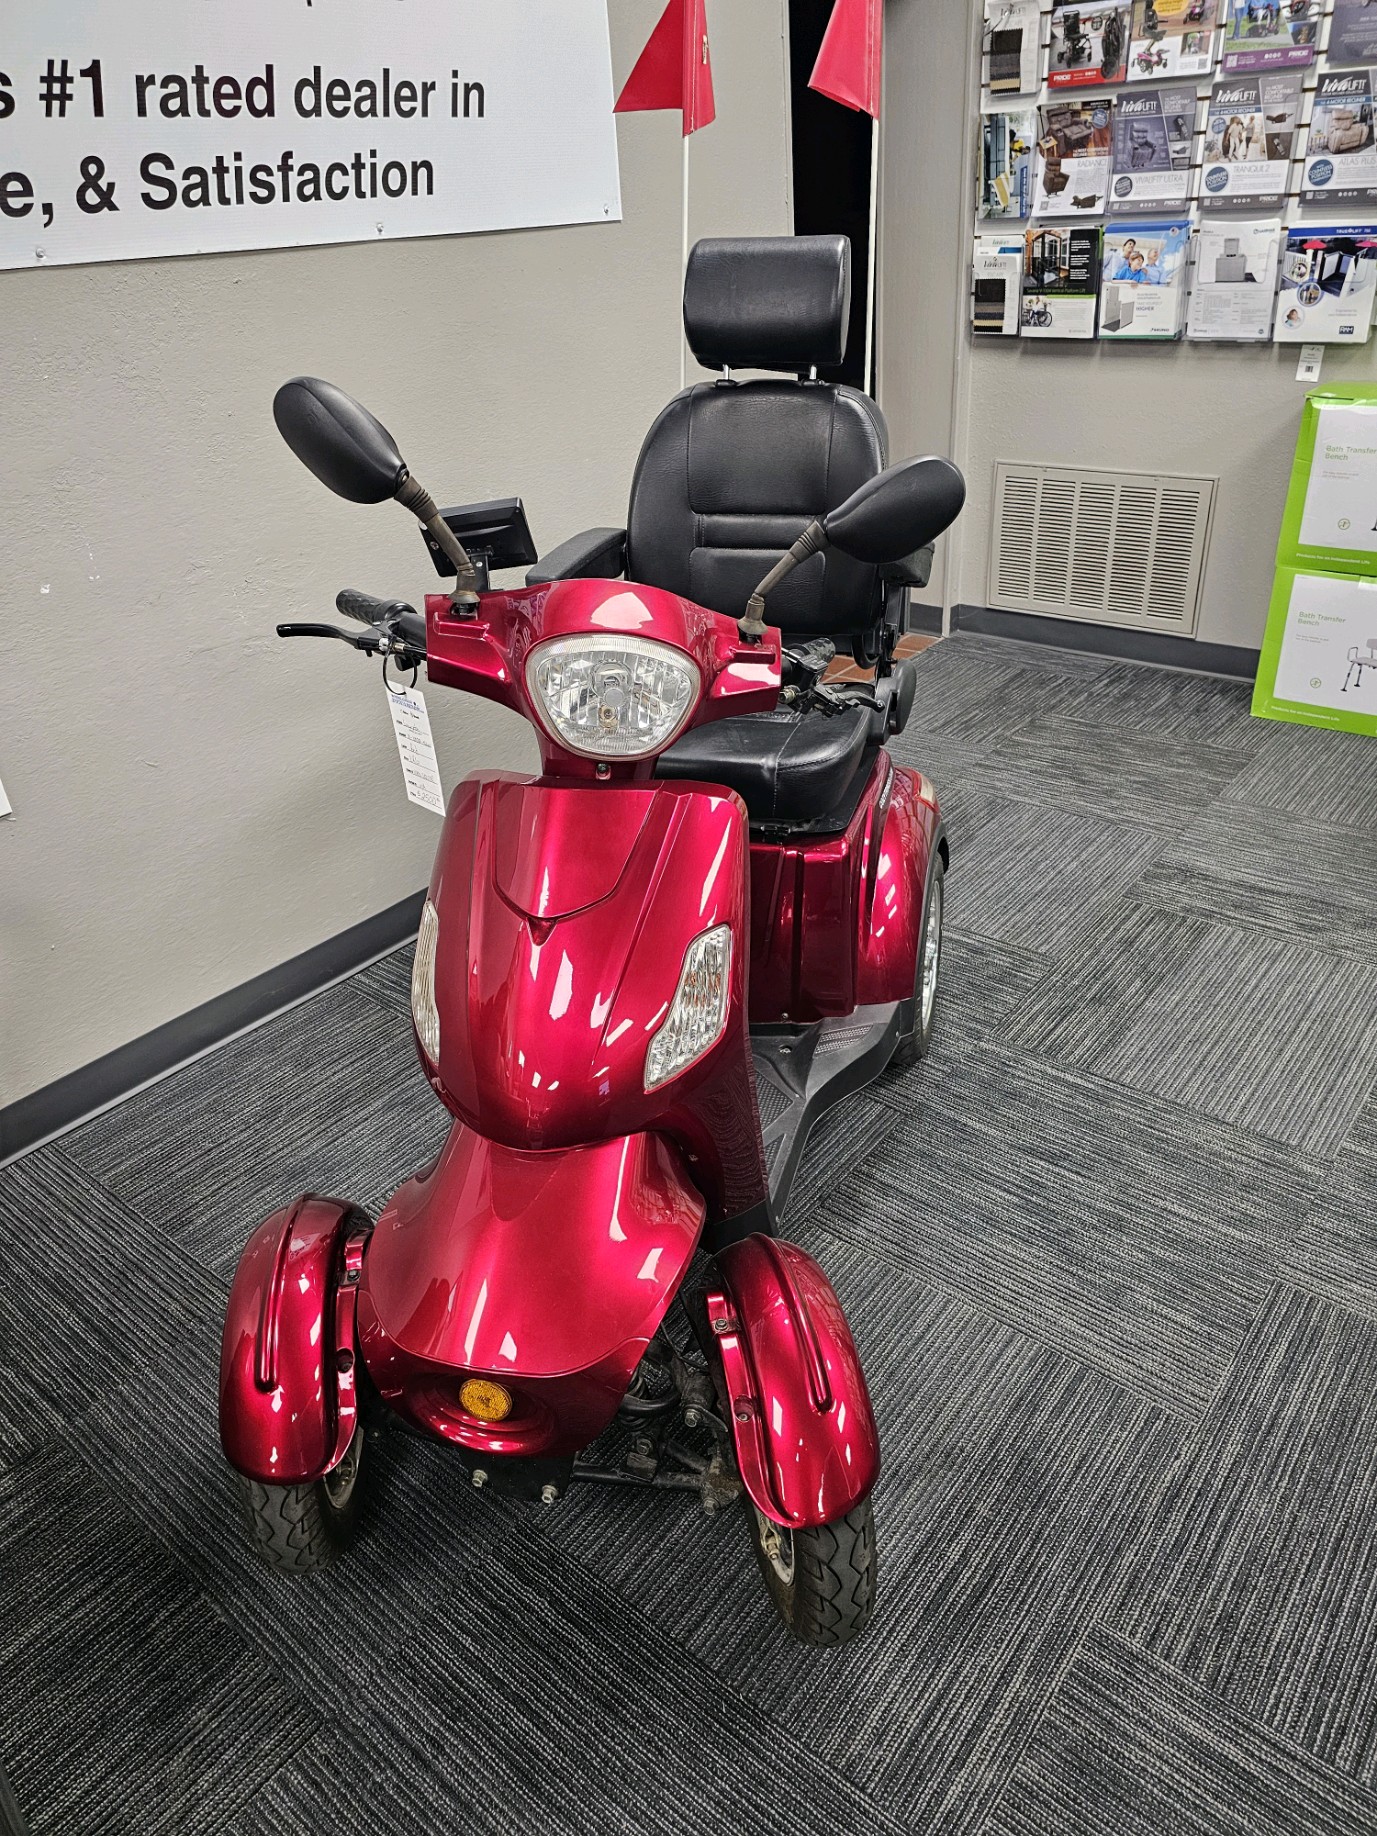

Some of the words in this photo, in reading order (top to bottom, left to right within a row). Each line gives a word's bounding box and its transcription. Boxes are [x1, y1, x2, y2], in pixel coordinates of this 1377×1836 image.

[1288, 50, 1309, 58] PRIDE
[39, 59, 105, 118] #1
[135, 64, 276, 119] rated
[294, 66, 436, 119] dealer
[451, 70, 486, 118] in
[76, 155, 120, 215] &
[140, 149, 434, 210] Satisfaction
[1326, 445, 1343, 453] Bath
[1346, 446, 1377, 454] Transfer
[1324, 453, 1349, 461] Bench
[1299, 611, 1315, 619] Bath
[1318, 614, 1346, 623] Transfer
[1297, 618, 1320, 626] Bench
